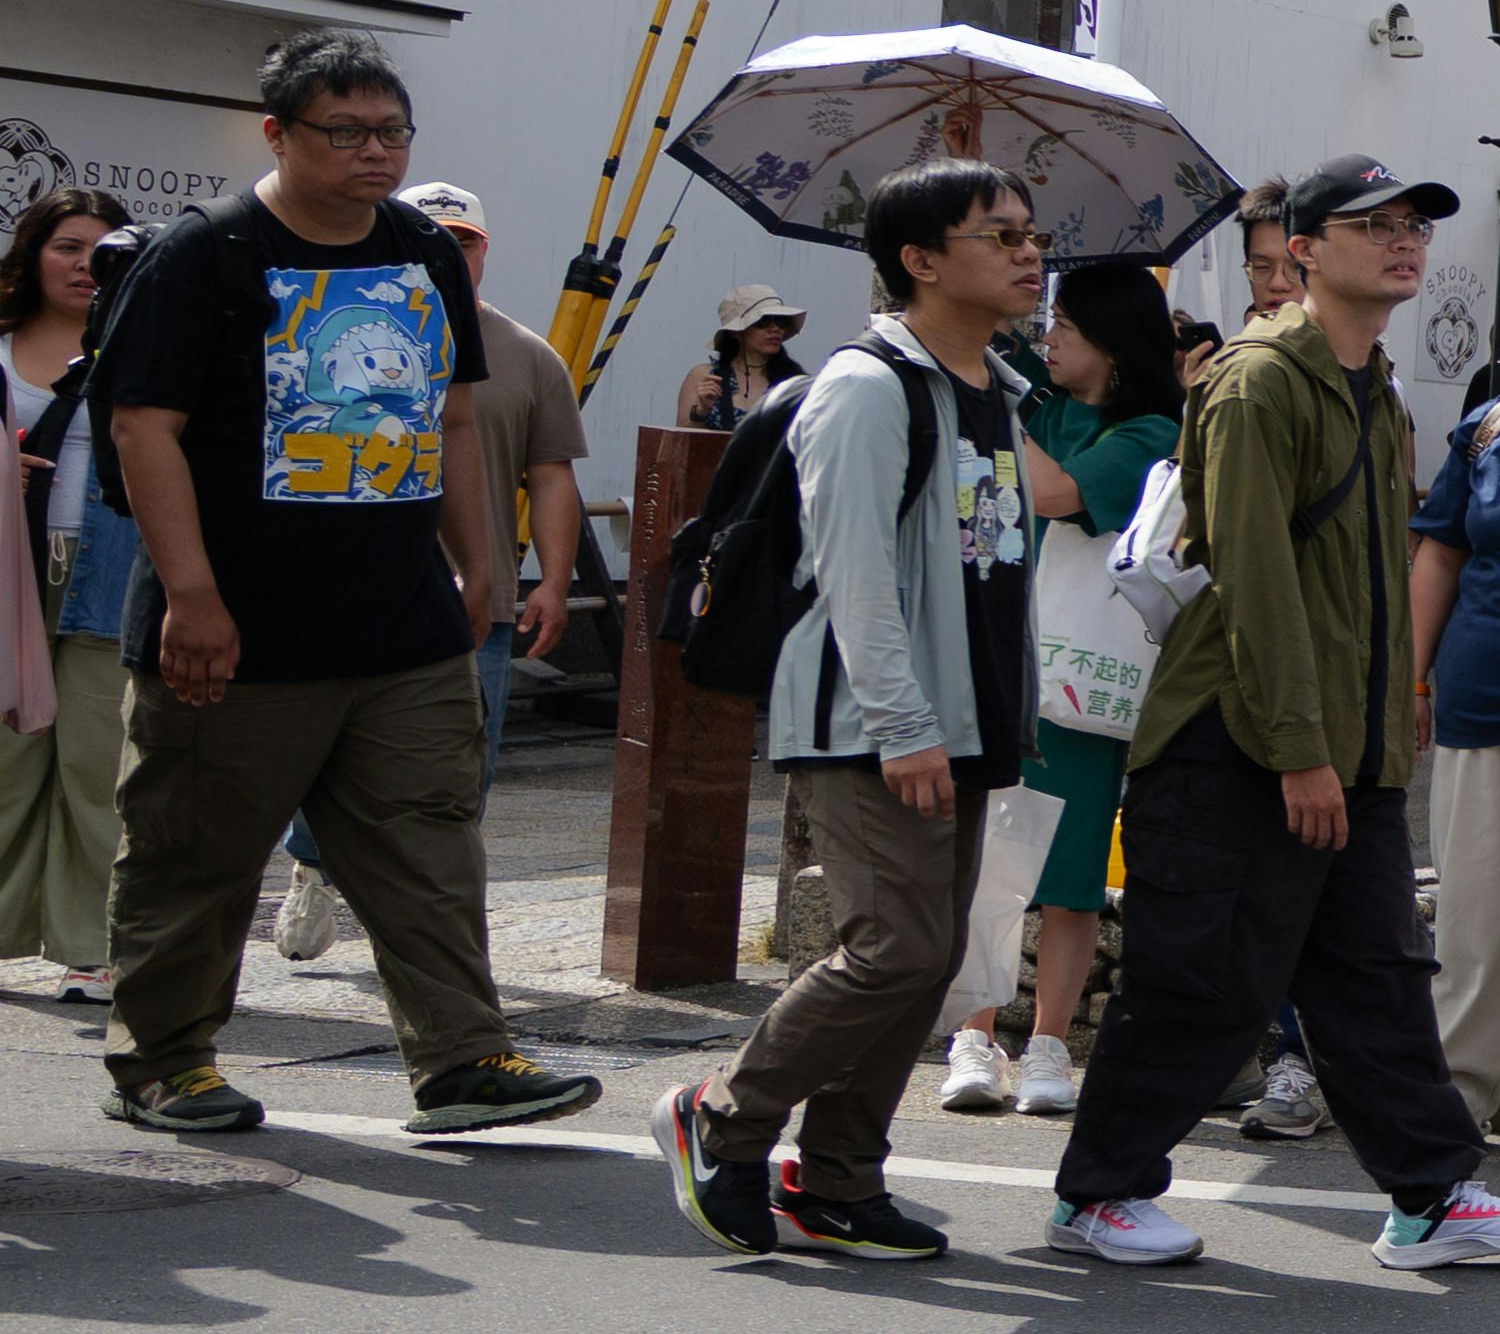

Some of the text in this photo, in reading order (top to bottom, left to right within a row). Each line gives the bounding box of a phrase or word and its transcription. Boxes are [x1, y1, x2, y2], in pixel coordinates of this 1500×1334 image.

[84, 162, 228, 198] SNOOPY
[1426, 265, 1486, 298] SNOOPY
[1040, 643, 1142, 690] 了不起的
[1087, 689, 1140, 724] 营养
